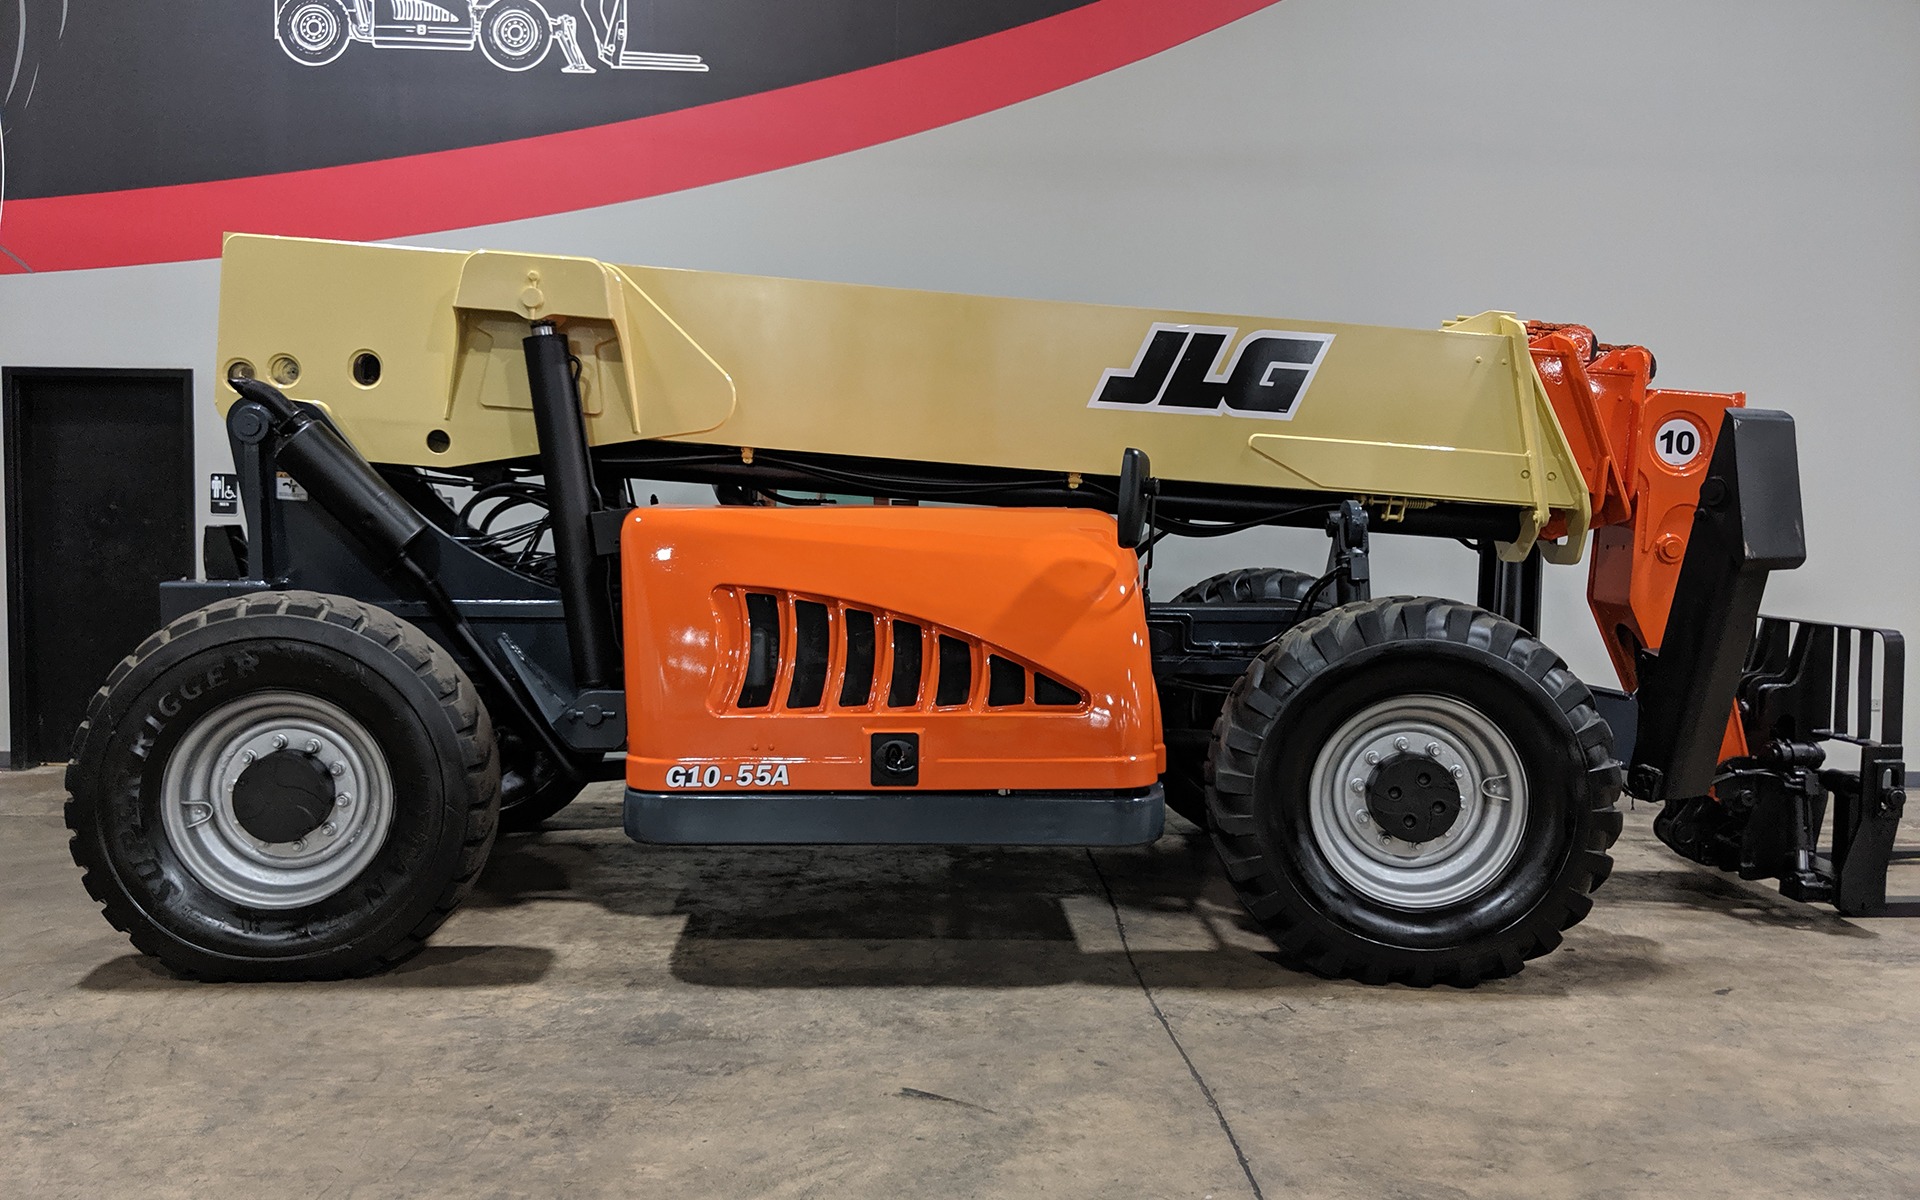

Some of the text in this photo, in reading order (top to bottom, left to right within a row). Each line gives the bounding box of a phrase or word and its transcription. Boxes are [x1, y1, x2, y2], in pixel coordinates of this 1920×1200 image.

[1095, 328, 1327, 415] JLG
[1660, 430, 1695, 455] 10
[665, 764, 790, 788] G10-55A
